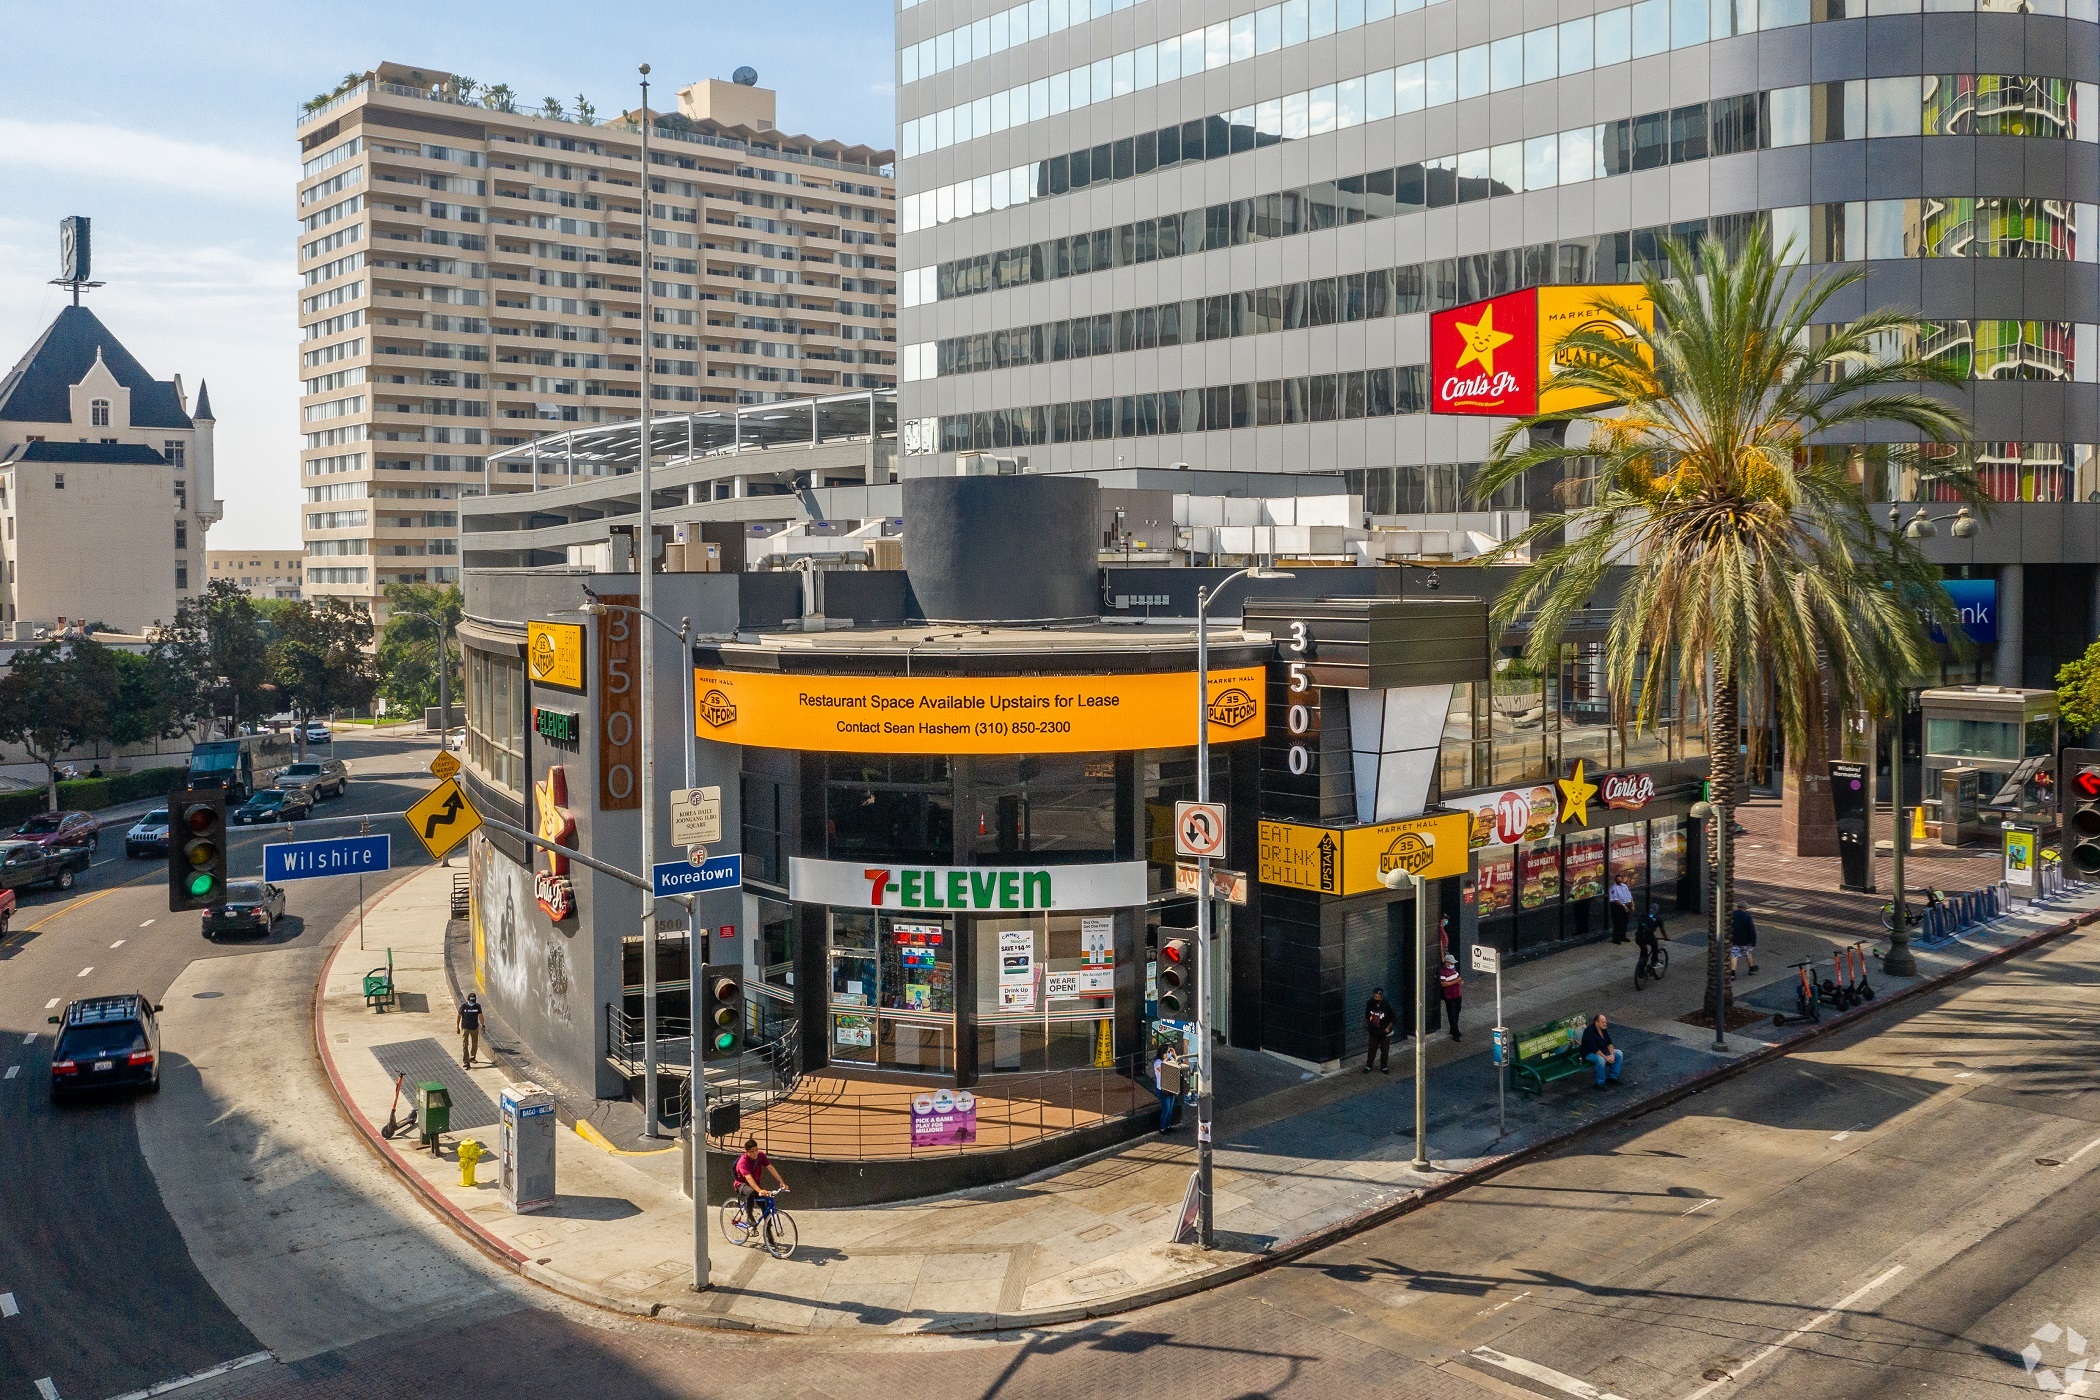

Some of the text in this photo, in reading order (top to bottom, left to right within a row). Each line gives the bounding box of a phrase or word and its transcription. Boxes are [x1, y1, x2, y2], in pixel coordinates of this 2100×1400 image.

[1549, 308, 1602, 321] MARKET
[1441, 371, 1520, 401] Carl's Jr.
[1207, 677, 1237, 685] MARKET
[607, 608, 634, 799] 3500
[710, 696, 721, 704] 35
[799, 692, 1120, 712] Restaurant Space Available Upstairs for Lease
[1226, 695, 1240, 704] 35
[1289, 621, 1309, 775] 3500
[1209, 705, 1255, 723] PLATFORM
[836, 721, 1071, 736] Contact Sean Hashem (310) 850-2300
[1605, 775, 1656, 799] Carl's Jr.
[675, 816, 703, 824] JOONGANG
[686, 821, 706, 830] SQUARE
[1377, 820, 1438, 834] MARKET HALL
[1499, 798, 1527, 837] $10
[1260, 824, 1293, 843] EAT
[1400, 840, 1414, 851] 35
[284, 848, 372, 871] Wilshire
[1260, 844, 1315, 867] DRINK
[1322, 837, 1332, 890] UPSTAIRS
[1383, 850, 1431, 871] PLATFORM
[1566, 854, 1585, 865] BEYOND
[661, 867, 733, 887] Koreatown
[1261, 864, 1316, 888] CHILL
[865, 869, 1051, 908] 7-ELEVEN
[1001, 932, 1020, 940] CAMEL
[1049, 984, 1076, 992] OPEN!
